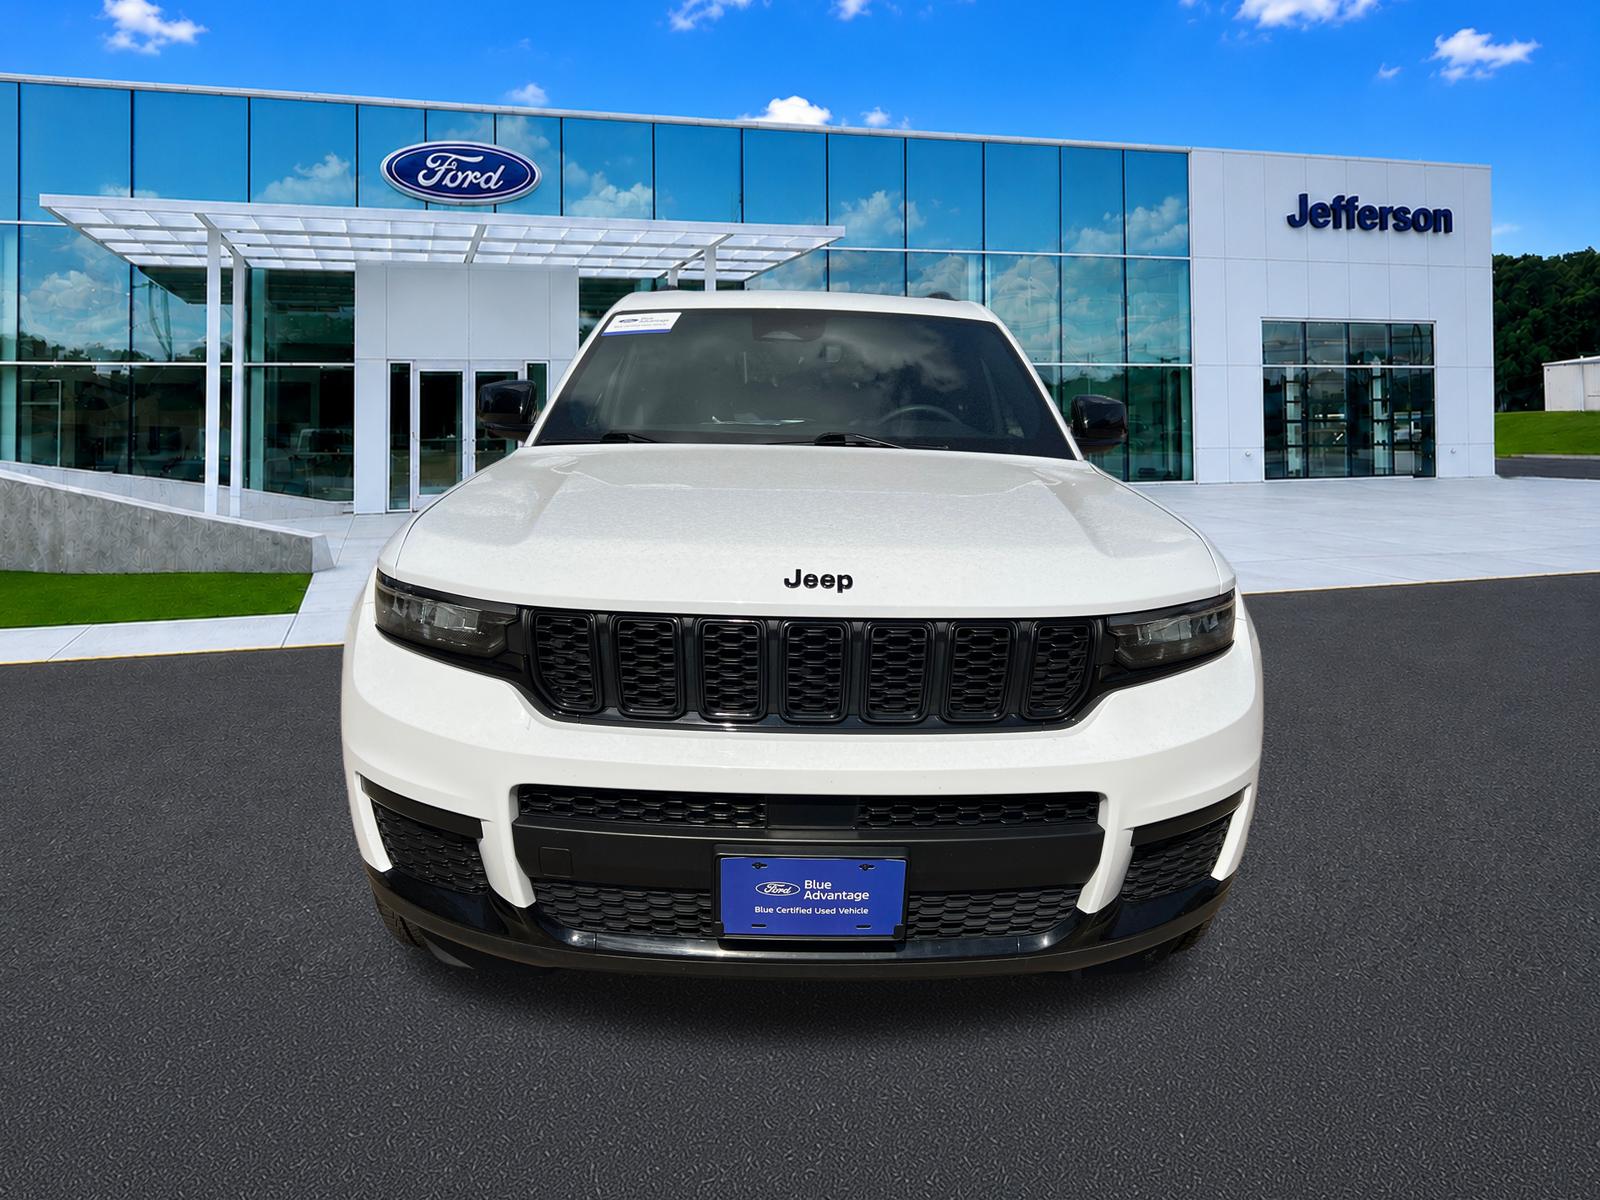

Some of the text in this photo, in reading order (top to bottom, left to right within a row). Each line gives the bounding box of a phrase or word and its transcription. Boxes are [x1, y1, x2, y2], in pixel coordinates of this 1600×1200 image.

[417, 152, 505, 189] Ford
[1287, 193, 1453, 233] Jefferson
[784, 569, 853, 593] Jeep
[764, 882, 792, 894] Ford
[804, 879, 832, 889] Blue
[803, 890, 870, 902] Advantage
[754, 906, 869, 915] Blue Certified Used Vehicle
